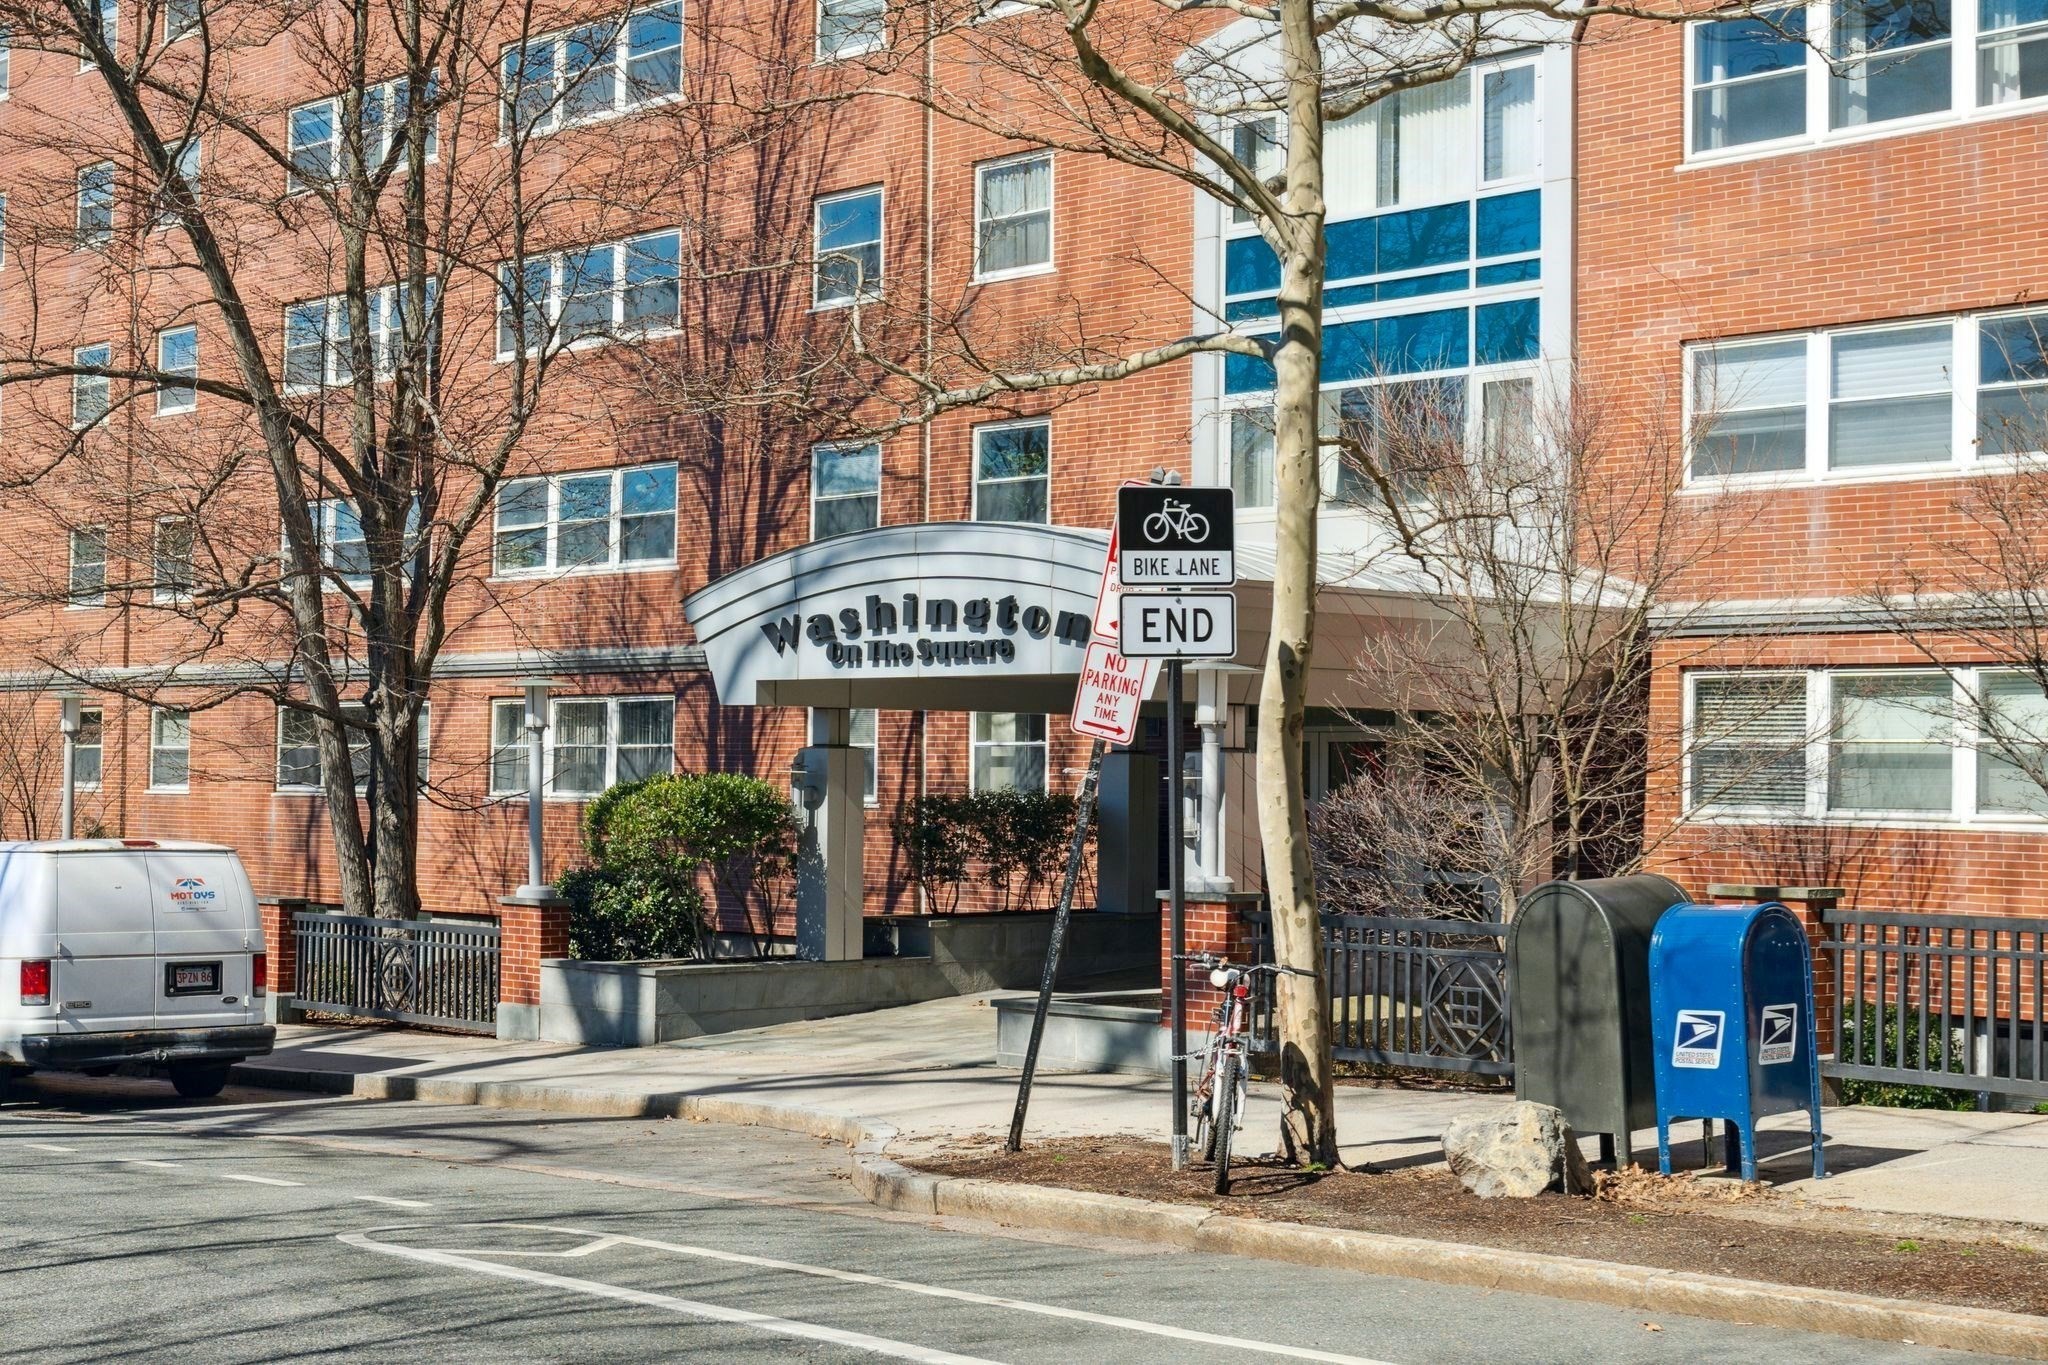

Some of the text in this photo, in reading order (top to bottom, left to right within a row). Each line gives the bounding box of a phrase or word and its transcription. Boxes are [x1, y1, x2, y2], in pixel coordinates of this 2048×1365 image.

[1133, 557, 1170, 576] BIKE
[1178, 557, 1220, 576] LANE
[760, 593, 1090, 658] Washington
[1142, 607, 1214, 643] END
[826, 638, 1015, 668] On The Square
[1104, 652, 1128, 673] NO
[1084, 668, 1139, 697] PARKING
[1096, 692, 1121, 708] ANY
[1093, 705, 1119, 723] TIME
[176, 971, 213, 984] 3PZN 86
